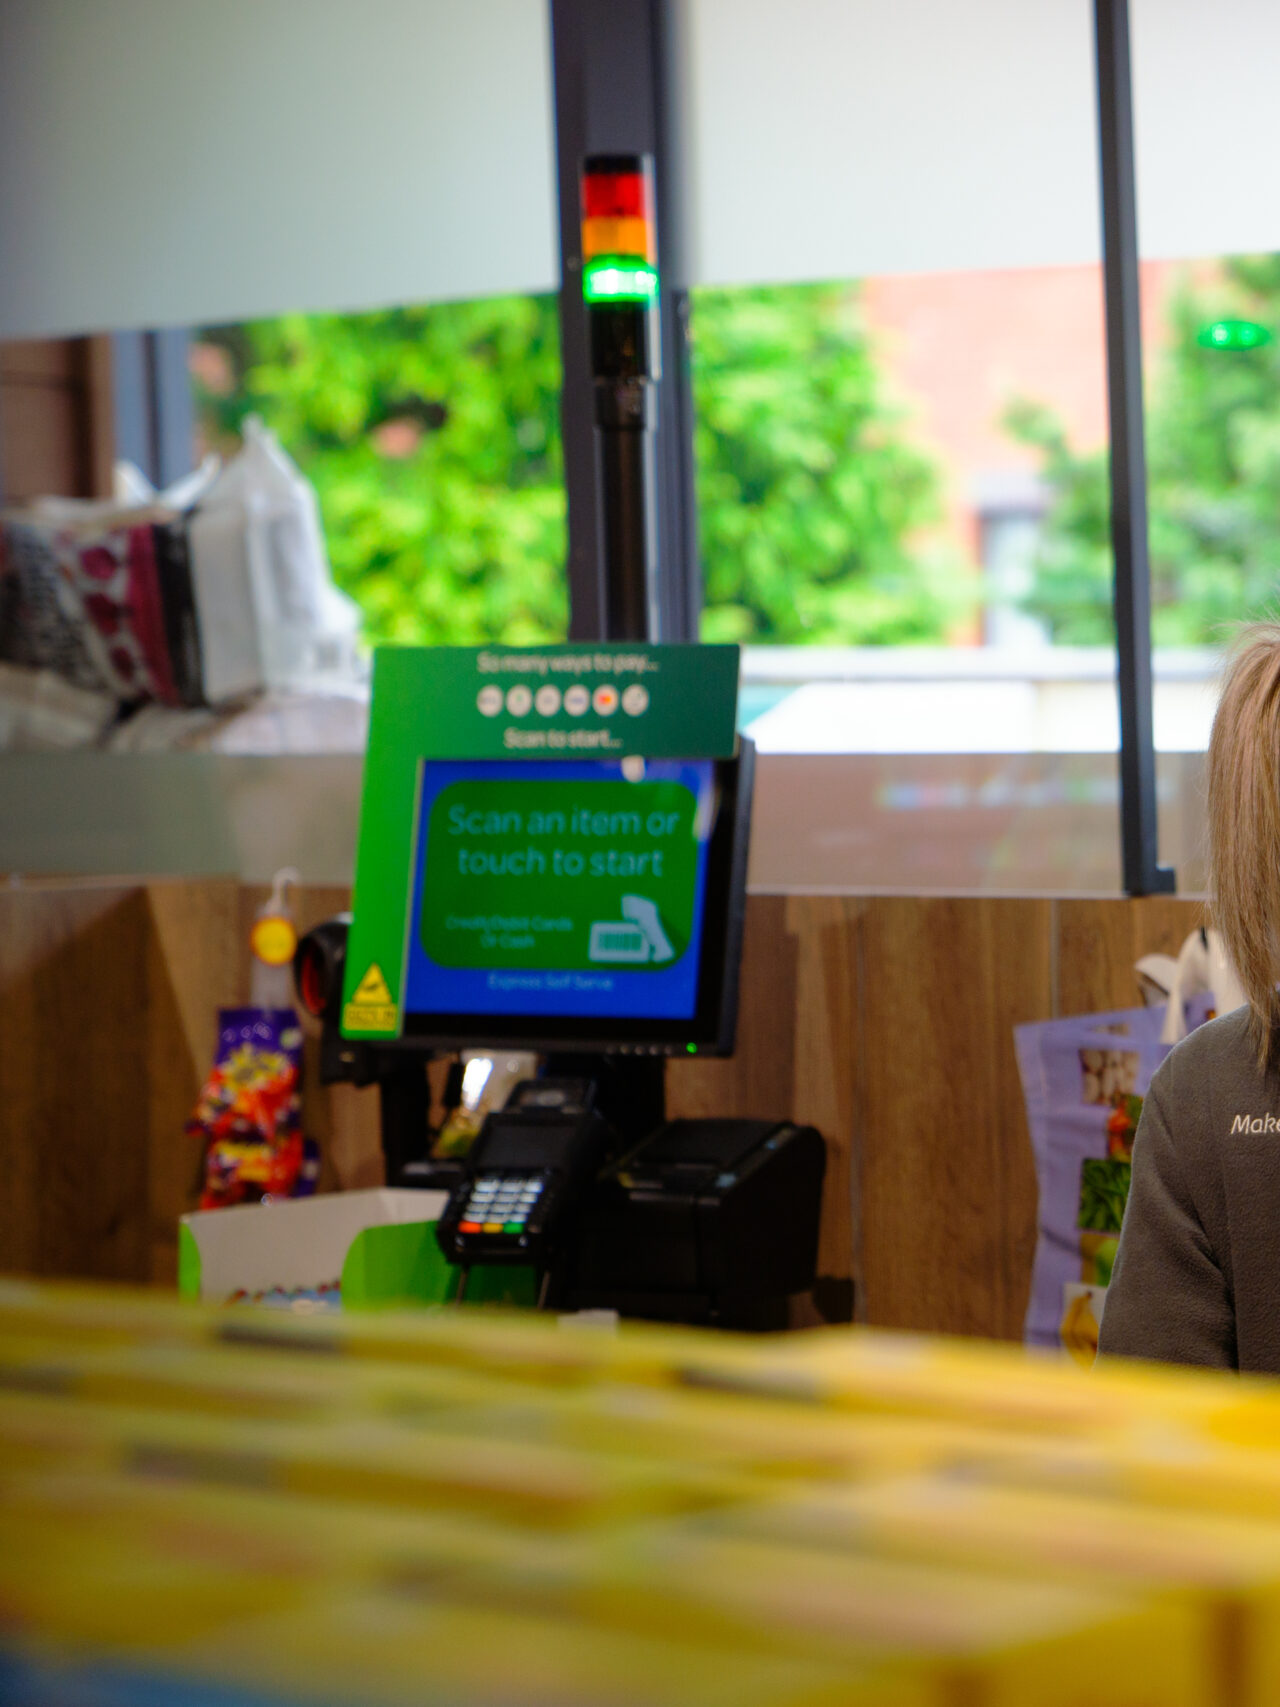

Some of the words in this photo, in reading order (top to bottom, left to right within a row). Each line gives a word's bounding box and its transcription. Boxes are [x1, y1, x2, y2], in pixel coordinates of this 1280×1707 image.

[477, 651, 500, 673] So
[502, 654, 549, 676] many
[550, 654, 593, 676] ways
[594, 653, 613, 672] to
[504, 727, 546, 748] Scan
[547, 729, 568, 748] to
[448, 803, 521, 835] Scan
[527, 809, 566, 835] an
[571, 804, 642, 836] item
[646, 810, 680, 837] or
[458, 846, 547, 875] touch
[553, 849, 585, 876] to
[589, 849, 664, 877] start
